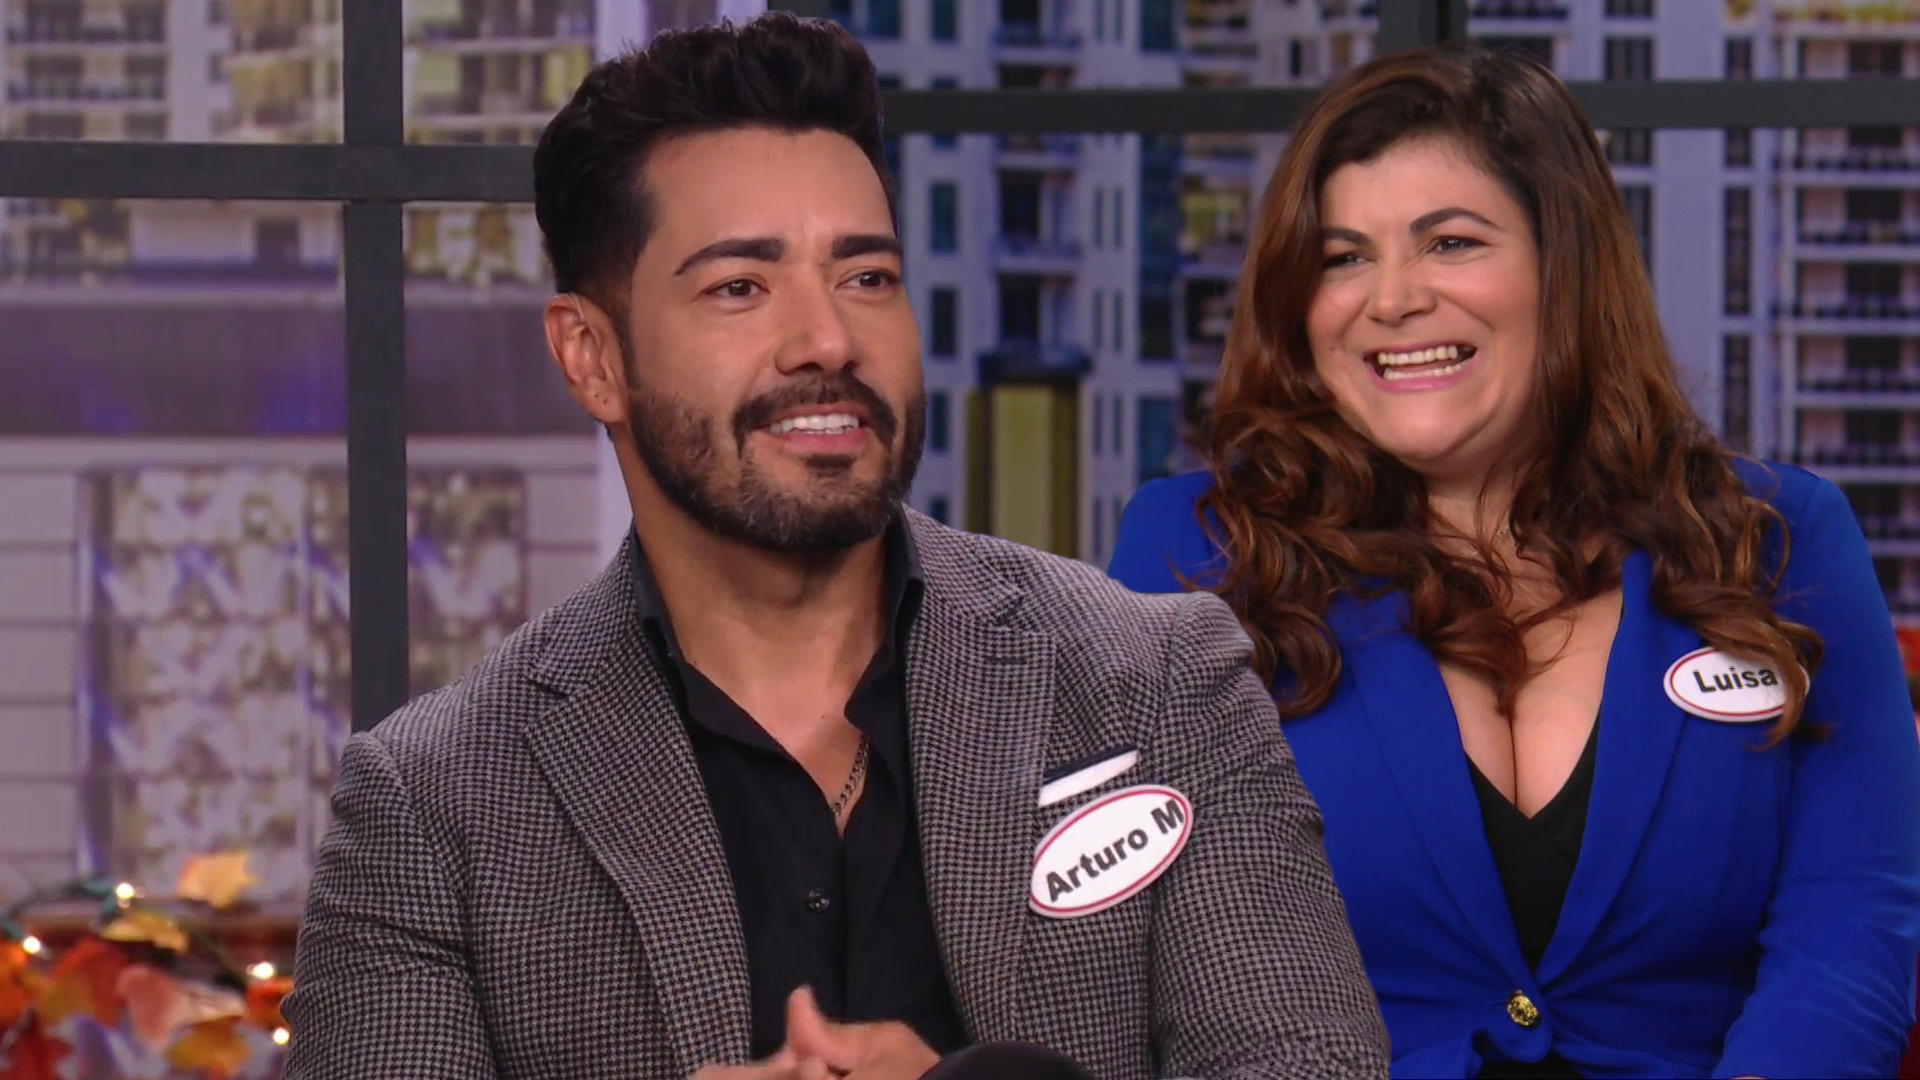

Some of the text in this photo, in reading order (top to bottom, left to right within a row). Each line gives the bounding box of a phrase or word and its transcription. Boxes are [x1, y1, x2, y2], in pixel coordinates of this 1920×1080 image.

[1693, 666, 1779, 694] Luisa
[1046, 798, 1184, 903] Arturo M
